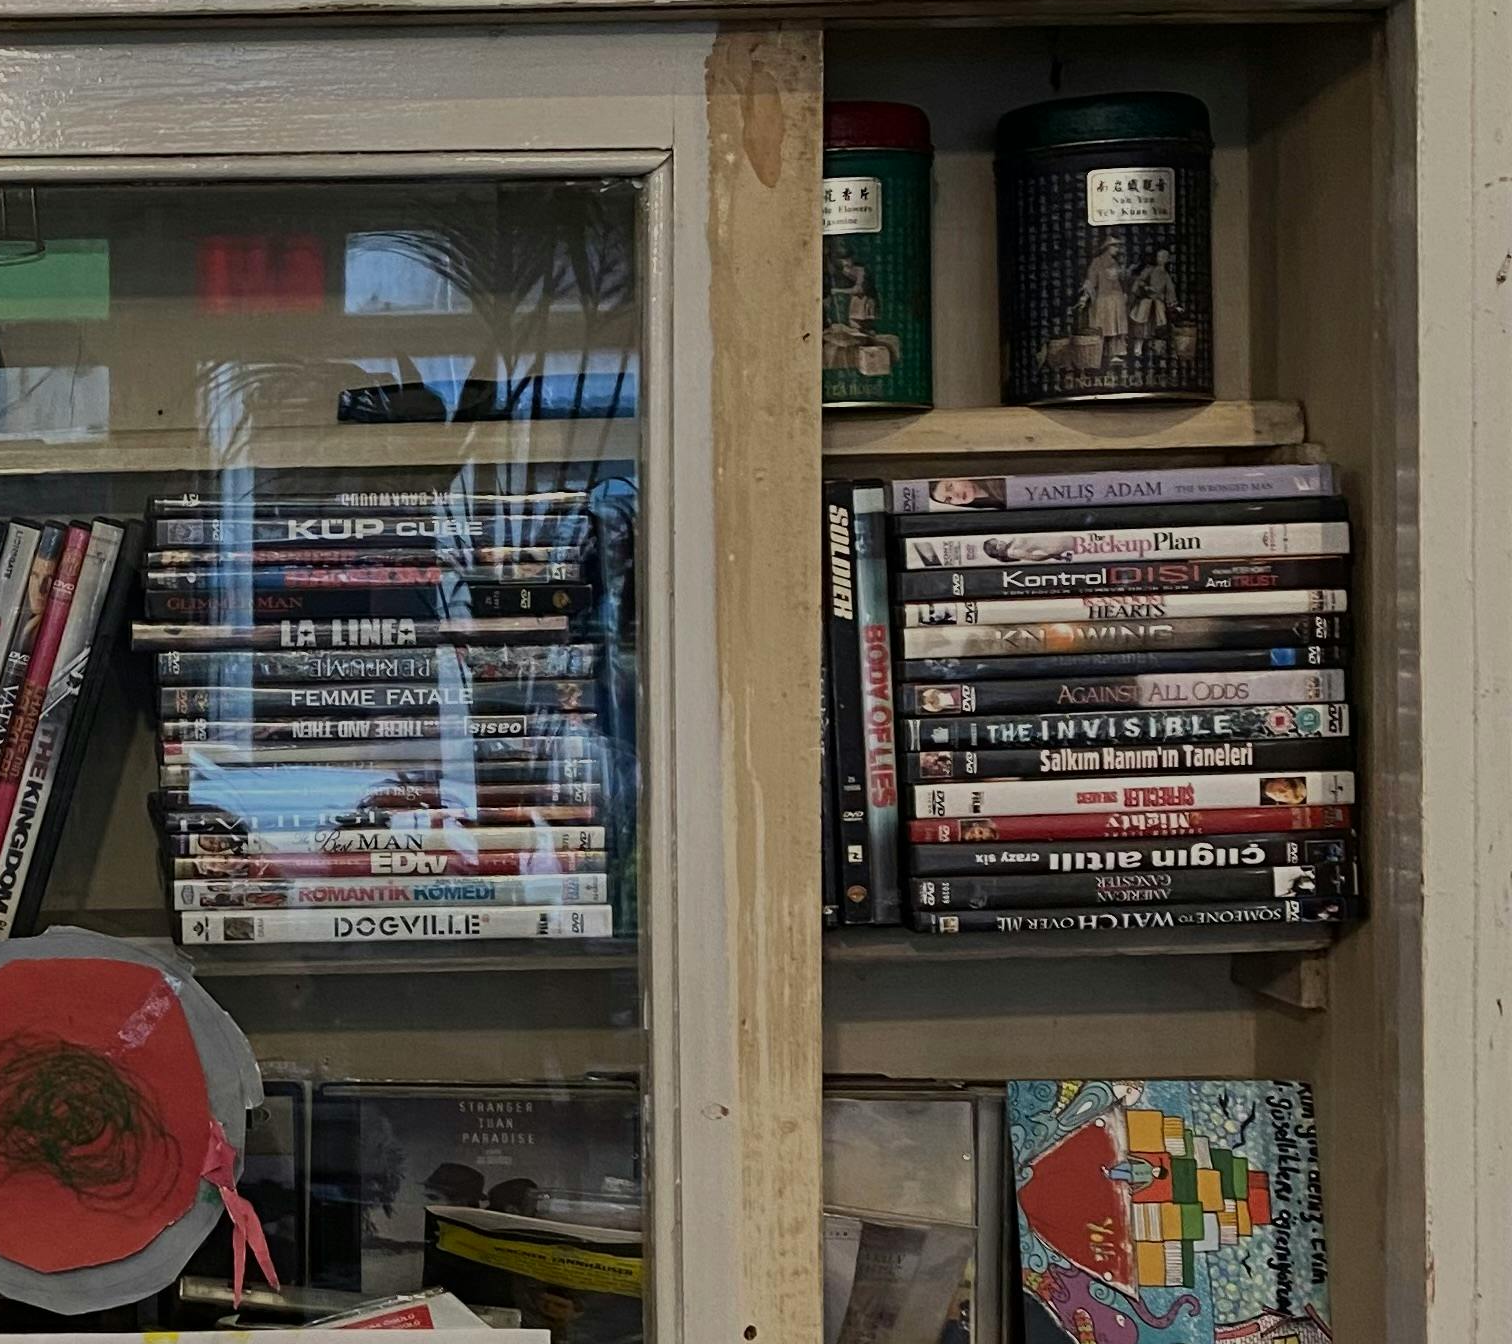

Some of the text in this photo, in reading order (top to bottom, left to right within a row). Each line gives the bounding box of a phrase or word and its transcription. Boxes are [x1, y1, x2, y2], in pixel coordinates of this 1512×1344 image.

[903, 487, 913, 513] DVD
[1024, 485, 1095, 506] YANLIŞ
[1104, 482, 1163, 500] ADAM
[288, 518, 485, 541] KÜP CUBE
[1088, 530, 1202, 552] The Plan
[828, 502, 854, 623] SOLDIER
[1001, 567, 1108, 588] Kontrol
[255, 595, 305, 610] MAN
[1087, 602, 1166, 620] HEARTS
[280, 617, 418, 648] LA LINEA
[310, 657, 432, 679] PERFUME
[289, 687, 475, 707] FEMME FATALE
[1056, 681, 1250, 705] AGAINST ALL ODDS
[864, 624, 897, 809] BODY OF LIES
[291, 720, 372, 739] AND THEN
[469, 719, 523, 736] oasis
[986, 714, 1234, 744] THE INVISIBLE
[1039, 742, 1255, 773] Salkım Hanım'ın Taneleri
[316, 829, 424, 855] Best MAN
[370, 852, 448, 876] EDtv
[974, 839, 1267, 873] çılgın altılı crazy six
[1094, 871, 1172, 890] GANGSTER
[1095, 886, 1172, 905] AMERICAN
[1027, 915, 1075, 930] OVER
[1077, 911, 1176, 932] WATCH
[1199, 903, 1283, 923] SOMEONE
[333, 913, 481, 938] DOGVILLE
[995, 916, 1023, 933] ME
[458, 1101, 534, 1114] STRANGER
[477, 1117, 514, 1129] THAN
[461, 1132, 537, 1146] PARADISE
